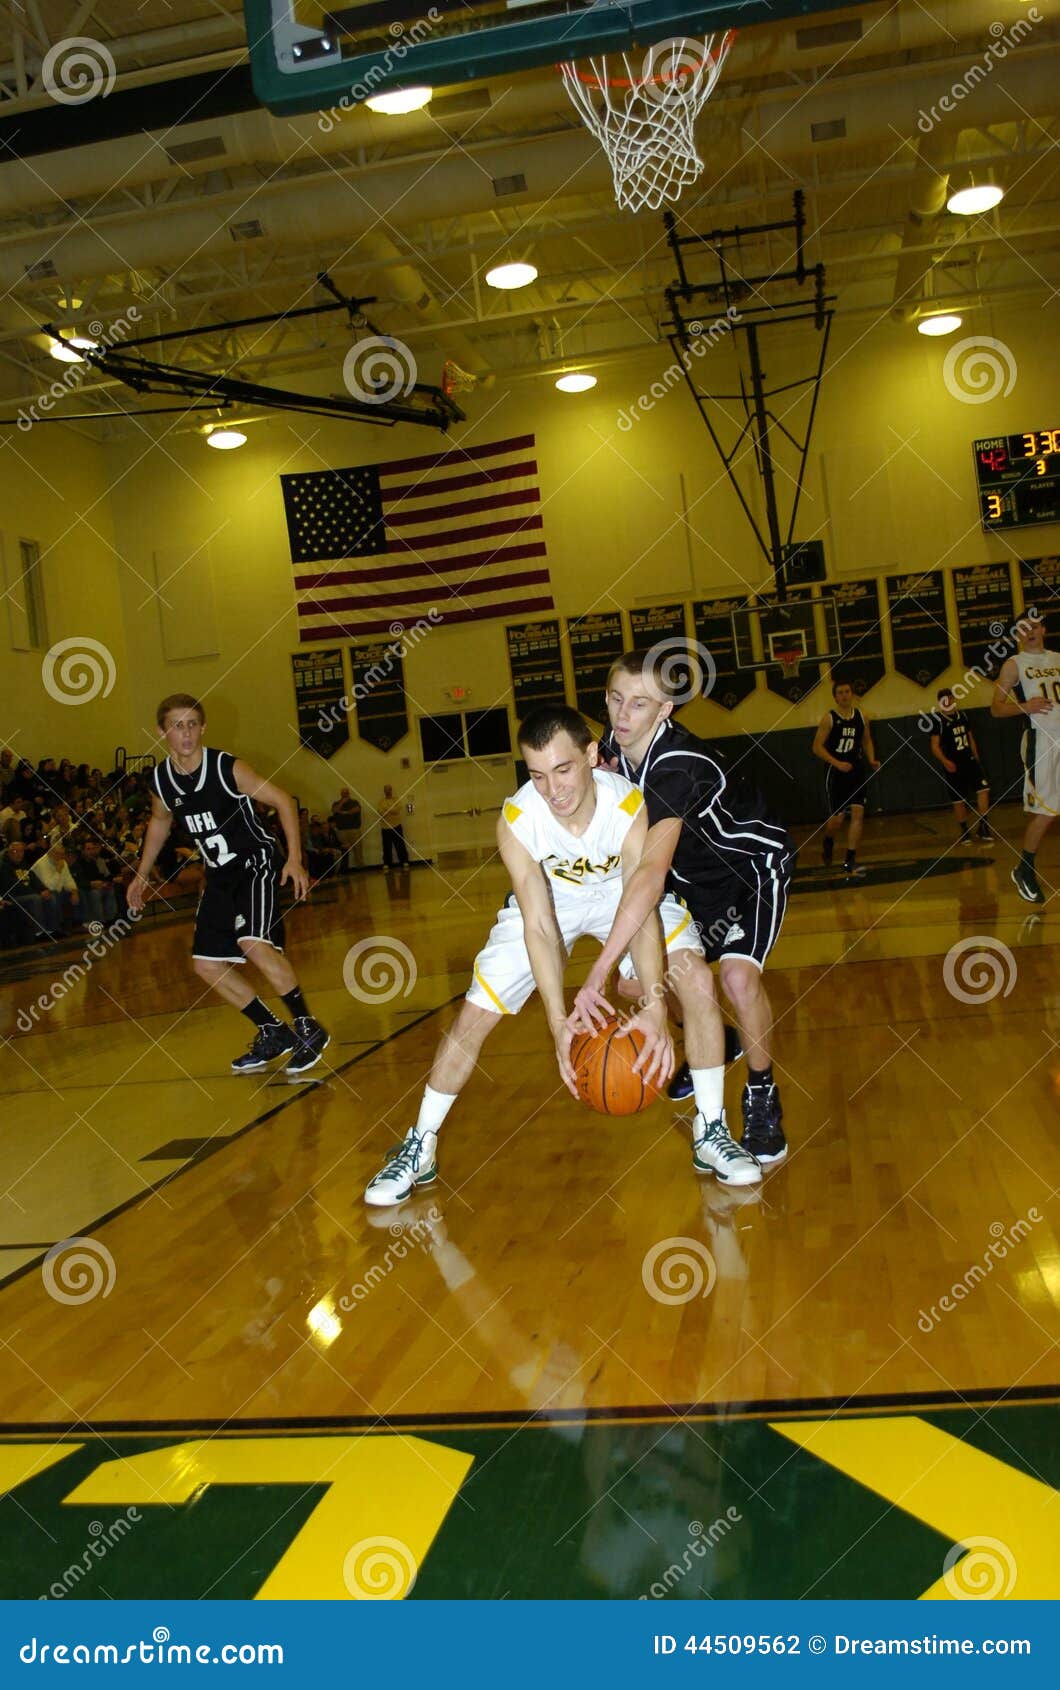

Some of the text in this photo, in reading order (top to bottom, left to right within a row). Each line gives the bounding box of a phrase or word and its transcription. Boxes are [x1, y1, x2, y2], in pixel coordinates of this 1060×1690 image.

[976, 438, 1005, 452] HOME
[980, 448, 1007, 472] 42
[1036, 459, 1046, 475] 3
[987, 495, 1002, 519] 3
[835, 738, 855, 753] 10
[194, 834, 238, 868] 12
